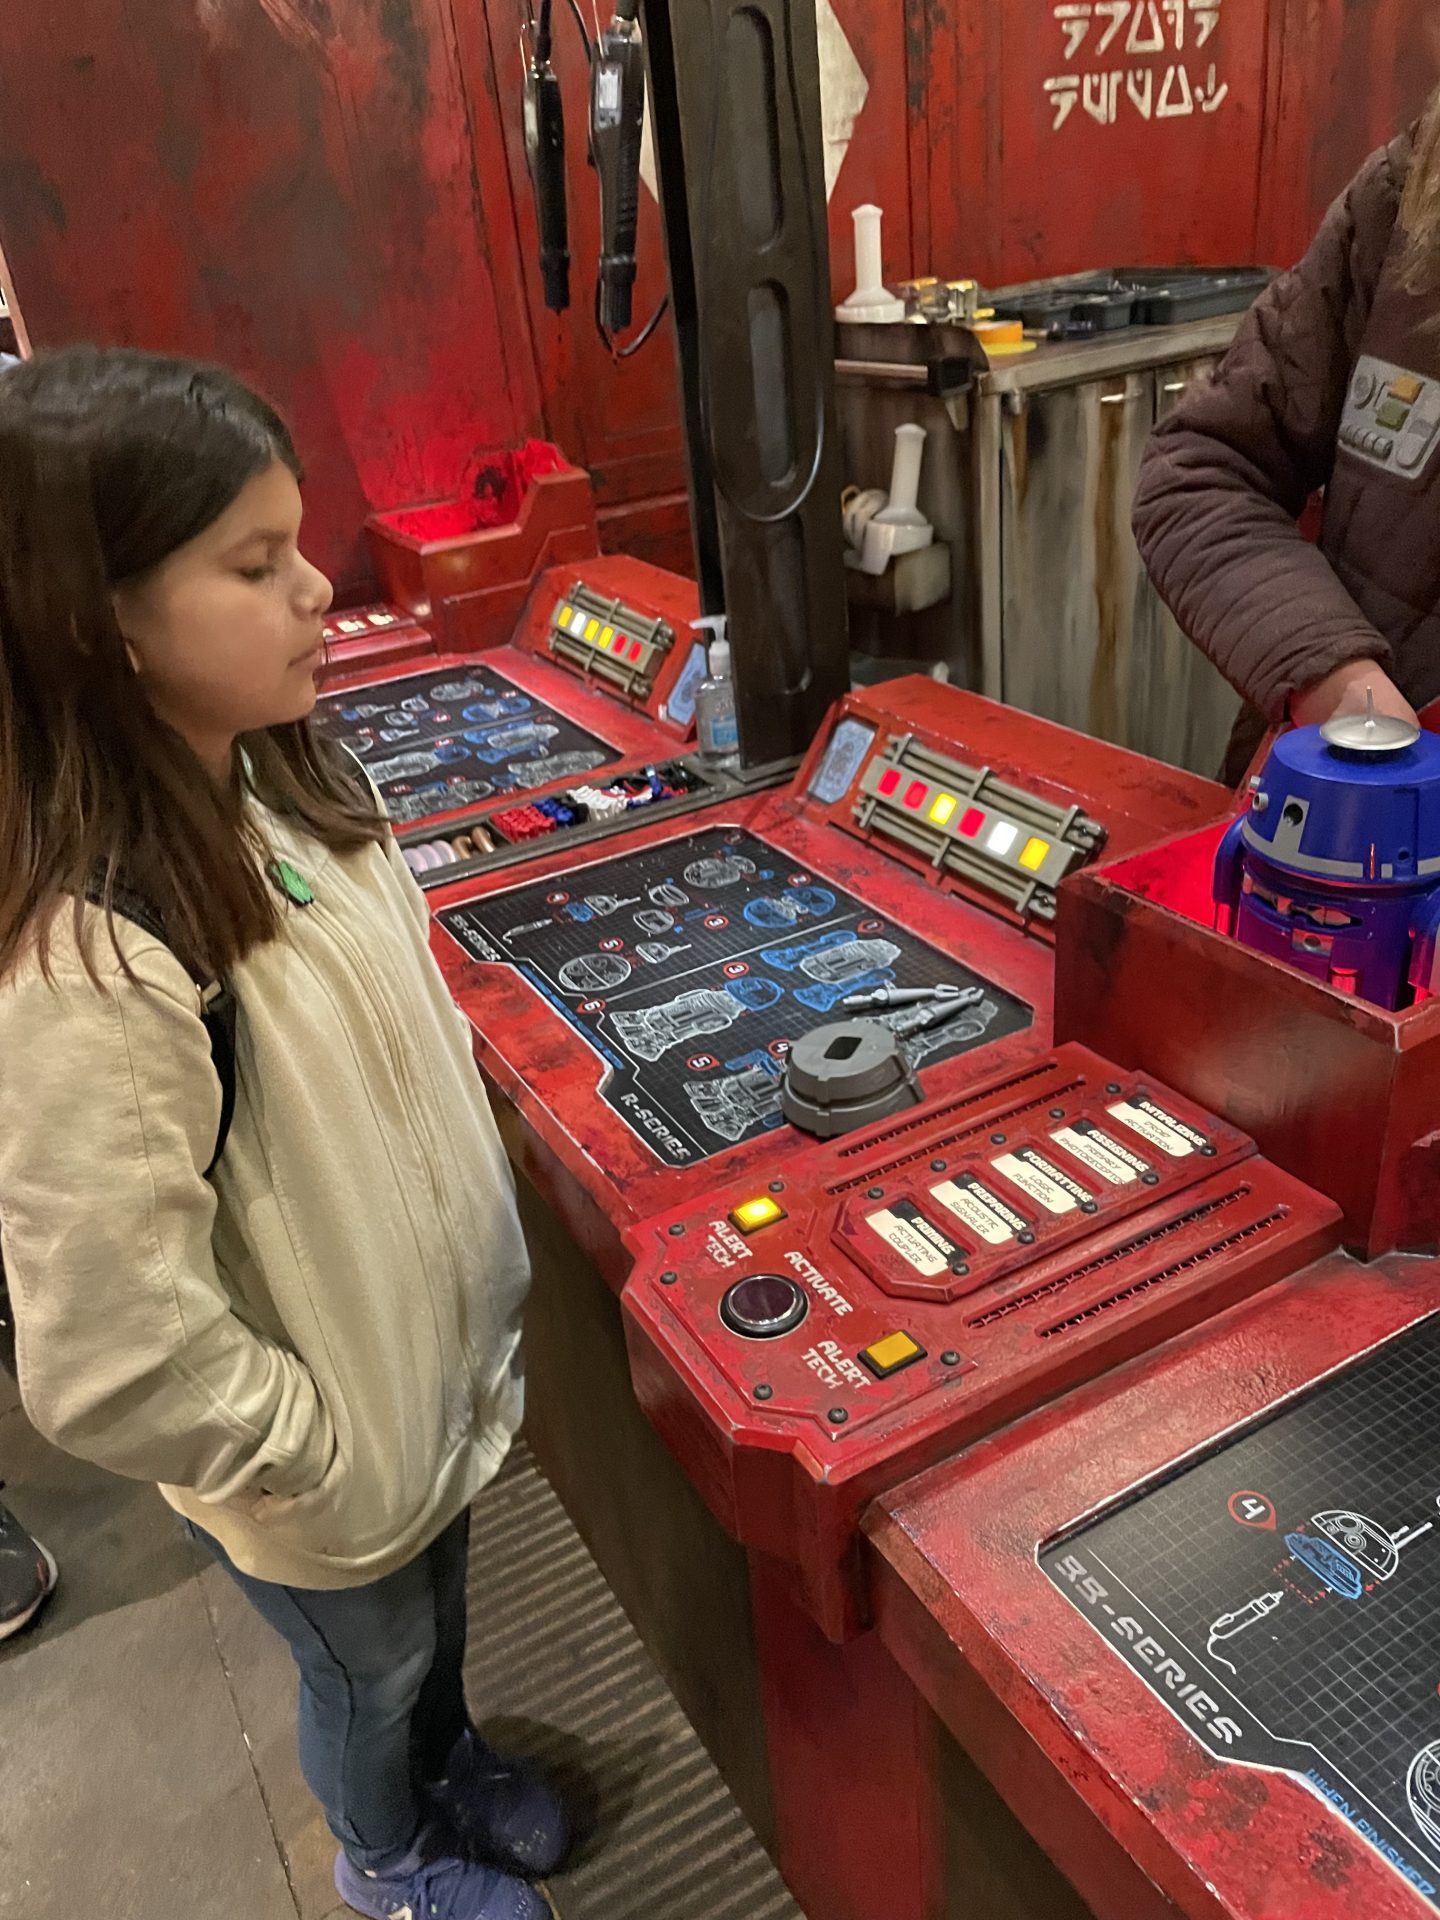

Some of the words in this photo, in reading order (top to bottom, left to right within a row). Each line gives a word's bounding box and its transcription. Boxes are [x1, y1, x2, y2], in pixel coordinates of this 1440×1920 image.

[603, 939, 619, 949] 5
[729, 964, 745, 974] 3
[583, 1000, 601, 1011] 6
[692, 1056, 710, 1068] 5
[620, 1092, 692, 1160] R-SERIES
[1124, 1118, 1174, 1150] ACTIVATION
[1139, 1101, 1207, 1146] INITIALIZING
[1143, 1120, 1172, 1138] DROID
[1083, 1144, 1122, 1169] PRIMARY
[1087, 1129, 1150, 1172] ASSIGNING
[1013, 1173, 1053, 1203] FUNCTION
[1022, 1151, 1094, 1203] FORMATTING
[1029, 1174, 1055, 1194] LOGIC
[950, 1201, 989, 1235] SIGNALER
[960, 1198, 999, 1229] ACOUSTIC
[967, 1182, 1027, 1230] PREPARING
[706, 1235, 736, 1268] TECH
[709, 1220, 753, 1259] ALERT
[888, 1233, 922, 1264] COUPLER
[893, 1225, 938, 1263] ACTUATING
[911, 1217, 955, 1254] PRIMING
[784, 1251, 853, 1316] ACTIVATE
[801, 1347, 843, 1389] TECH
[817, 1340, 871, 1389] ALERT
[1241, 1498, 1266, 1520] 4
[1304, 1768, 1356, 1819] WHEN
[1354, 1817, 1436, 1896] FINISHED
